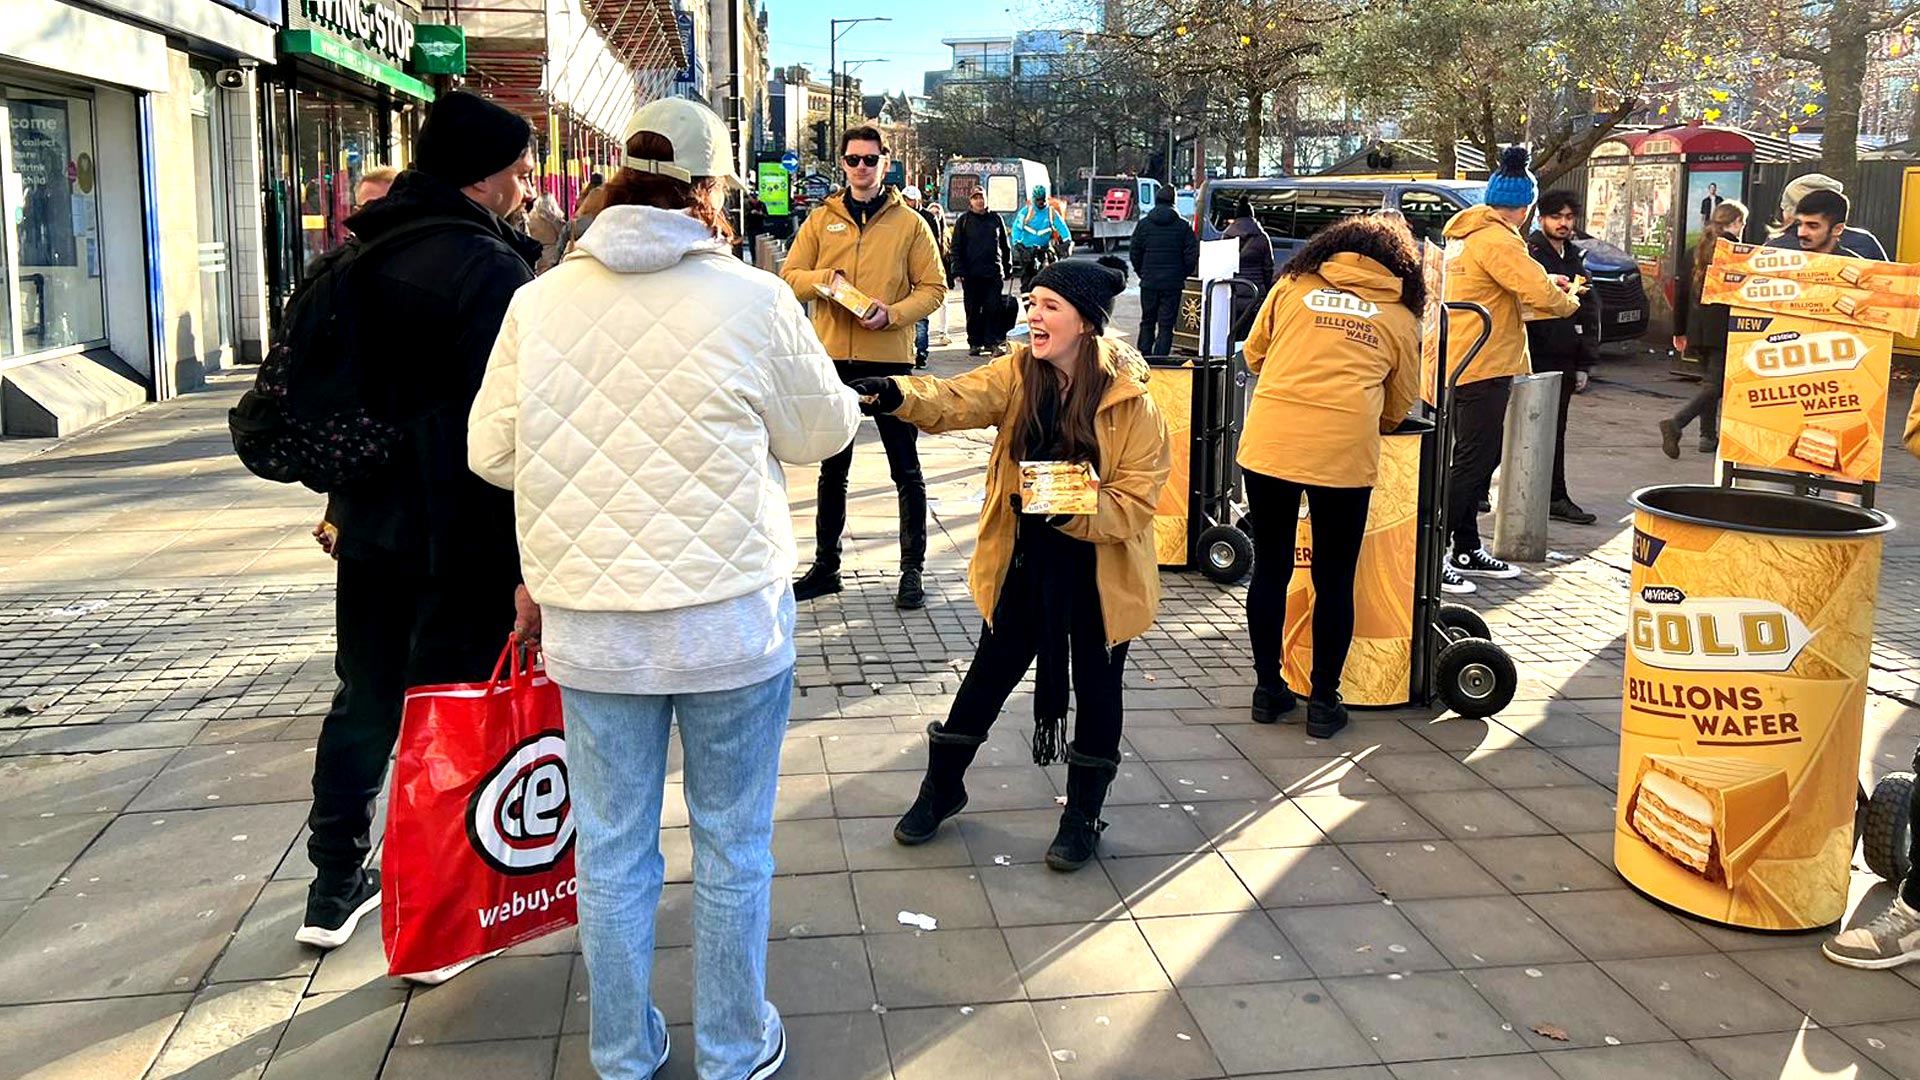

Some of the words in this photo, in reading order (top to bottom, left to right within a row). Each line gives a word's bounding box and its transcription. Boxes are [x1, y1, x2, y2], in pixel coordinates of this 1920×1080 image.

[1755, 255, 1801, 269] GOLD
[1746, 284, 1796, 298] GOLD
[1311, 294, 1372, 313] GOLD
[1315, 315, 1373, 333] BILLIONS
[1736, 317, 1763, 331] NEW
[1346, 329, 1379, 345] WAFER
[1755, 338, 1857, 371] GOLD
[1747, 380, 1840, 403] BILLIONS
[1800, 394, 1861, 411] WAFER
[1633, 610, 1789, 656] GOLD
[1629, 677, 1763, 711] BILLIONS
[1690, 711, 1800, 737] WAFER
